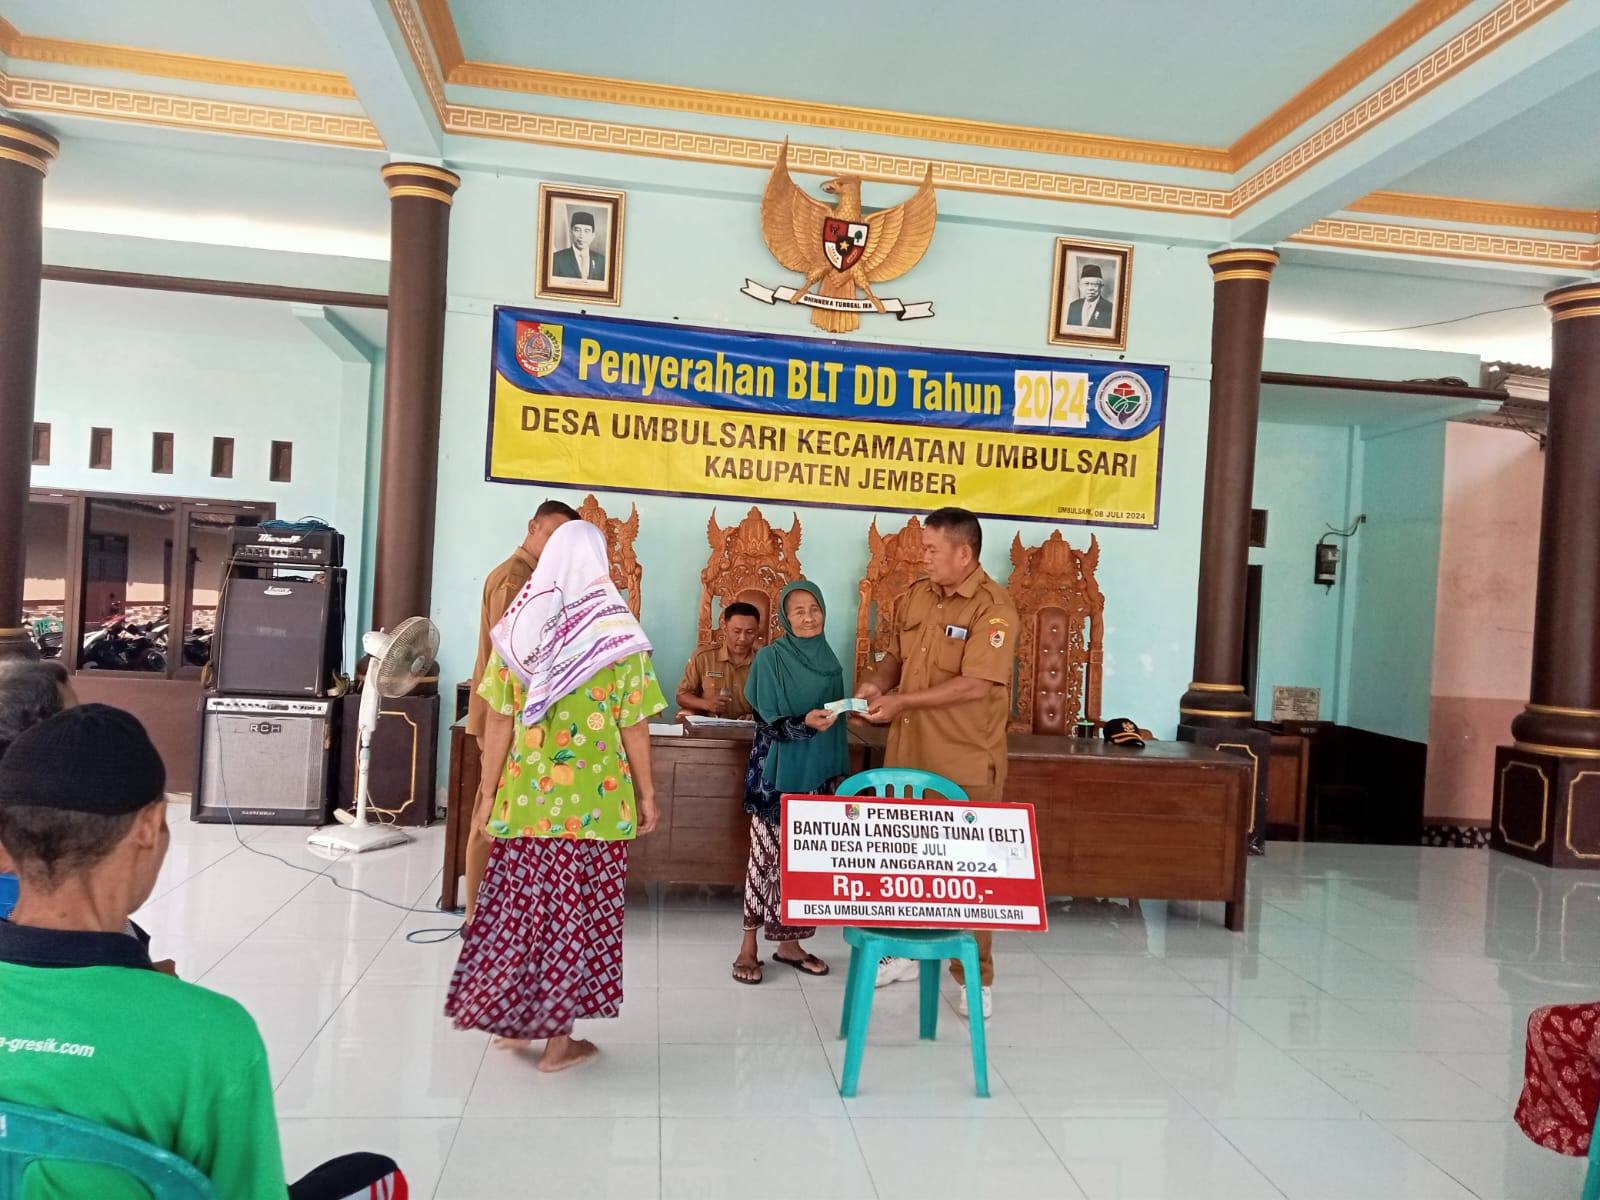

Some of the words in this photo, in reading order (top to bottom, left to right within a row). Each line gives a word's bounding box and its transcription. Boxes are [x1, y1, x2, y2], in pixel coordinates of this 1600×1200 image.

[579, 338, 775, 396] Penyerahan
[787, 359, 843, 403] BLT
[854, 365, 897, 407] DD
[908, 369, 1001, 415] Tahun
[1016, 374, 1086, 422] 2024
[521, 406, 600, 437] DESA
[612, 413, 785, 452] UMBULSARI
[798, 429, 966, 465] KECAMATAN
[976, 443, 1137, 478] UMBULSARI
[705, 456, 850, 487] KABUPATEN
[858, 468, 956, 495] JEMBER
[867, 808, 954, 822] PEMBERIAN
[793, 821, 860, 837] BANTUAN
[865, 823, 939, 839] LANGSUNG
[943, 826, 984, 841] TUNAI
[989, 827, 1025, 844] (BLT)
[793, 839, 827, 851] DANA
[831, 840, 862, 852] DESA
[866, 841, 918, 854] PERIODE
[922, 843, 946, 856] JULI
[830, 857, 875, 868] TAHUN
[880, 858, 953, 871] ANGGARAN
[956, 861, 998, 873] 2024
[833, 874, 871, 901] Rp.
[880, 876, 993, 904] 300.000,-
[804, 904, 831, 915] DESA
[834, 905, 895, 916] UMBULSARI
[898, 906, 961, 918] KECAMATAN
[964, 908, 1024, 920] UMBULSARI
